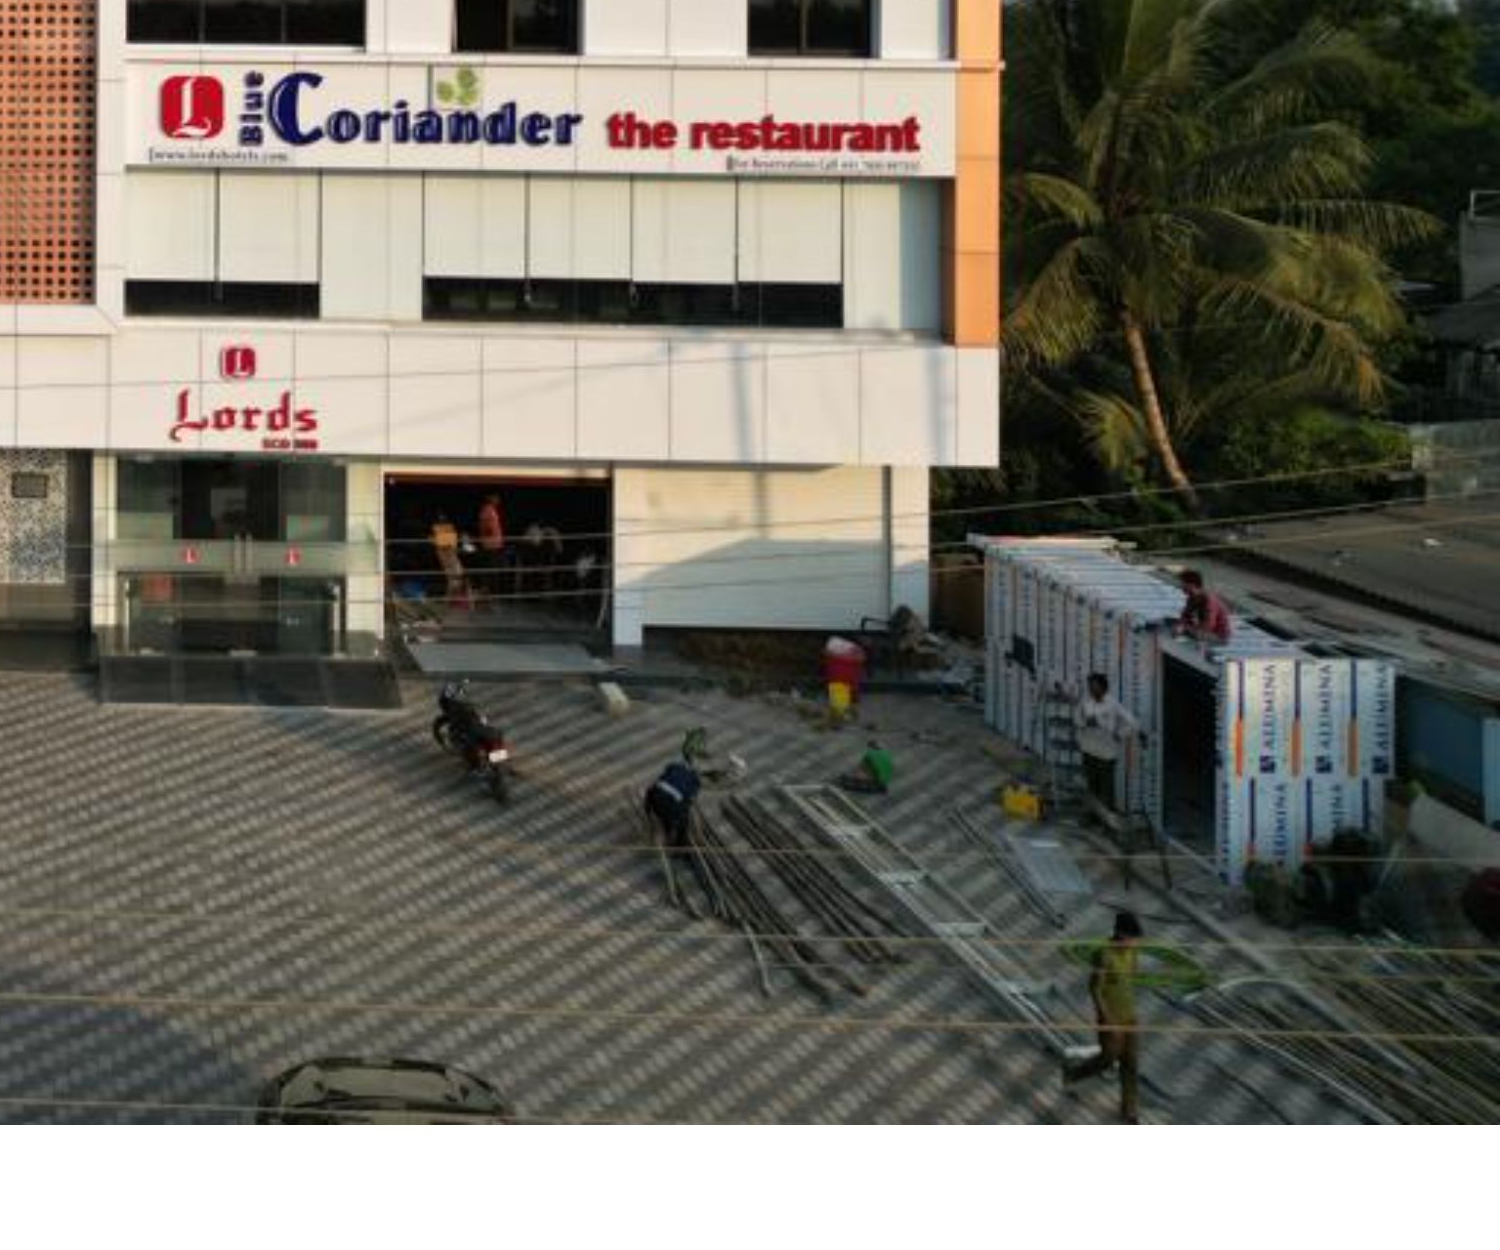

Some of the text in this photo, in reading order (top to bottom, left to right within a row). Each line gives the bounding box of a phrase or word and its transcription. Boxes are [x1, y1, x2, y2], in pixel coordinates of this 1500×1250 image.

[238, 71, 264, 146] Blue
[268, 72, 921, 151] Coriander the restaurant
[169, 388, 318, 442] Lords
